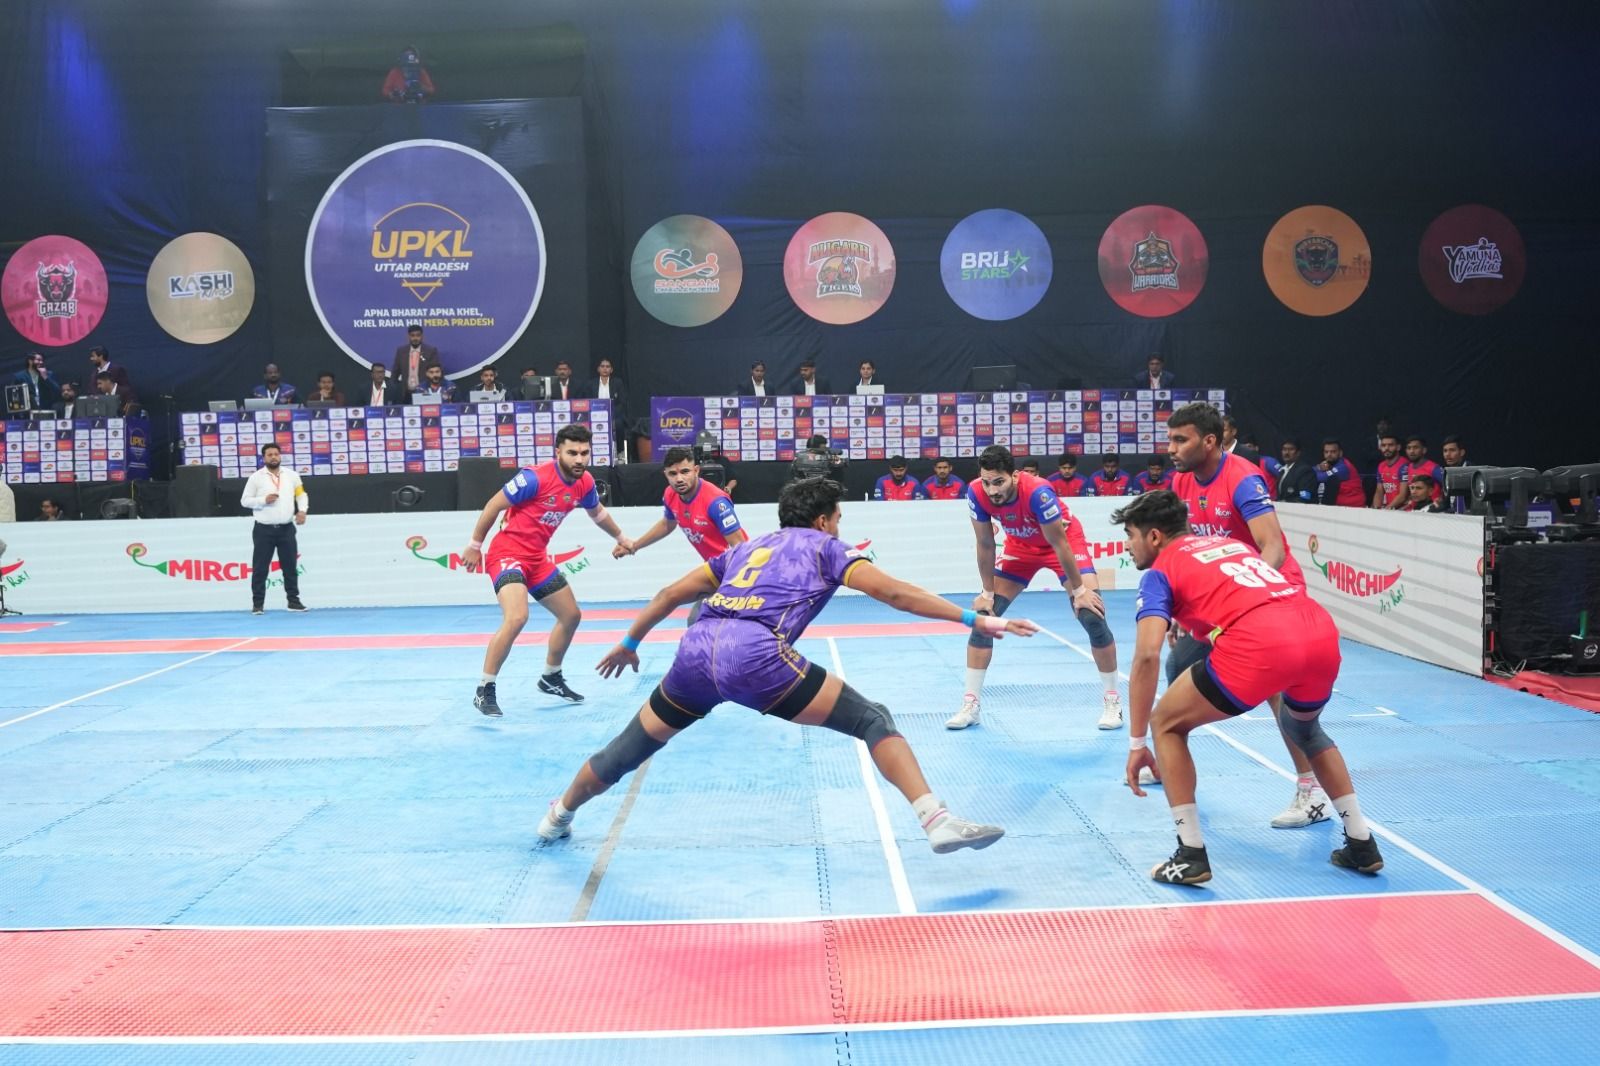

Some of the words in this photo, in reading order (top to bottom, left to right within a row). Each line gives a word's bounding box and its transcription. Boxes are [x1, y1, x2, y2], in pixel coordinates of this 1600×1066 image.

[371, 230, 473, 259] UPKL
[810, 240, 870, 263] ALIGARH
[961, 250, 1009, 269] BRIJ
[1442, 246, 1501, 267] YAMUNA
[374, 263, 413, 273] UTTAR
[414, 262, 470, 272] PRADESH
[961, 268, 1009, 280] STARS
[170, 273, 233, 293] KASHI
[821, 284, 860, 293] TIGERS
[40, 302, 75, 314] GAZAB
[364, 309, 390, 318] APNA
[391, 309, 428, 317] BHARAT
[429, 308, 455, 316] APNA
[456, 308, 483, 317] KHEL,
[353, 320, 377, 328] KHEL
[379, 319, 404, 327] RAHA
[406, 319, 422, 327] HAI
[424, 319, 450, 327] MERA
[451, 318, 494, 327] PRADESH
[660, 417, 694, 428] UPKL
[169, 559, 253, 581] MIRCH
[1328, 560, 1383, 597] MIRCHI
